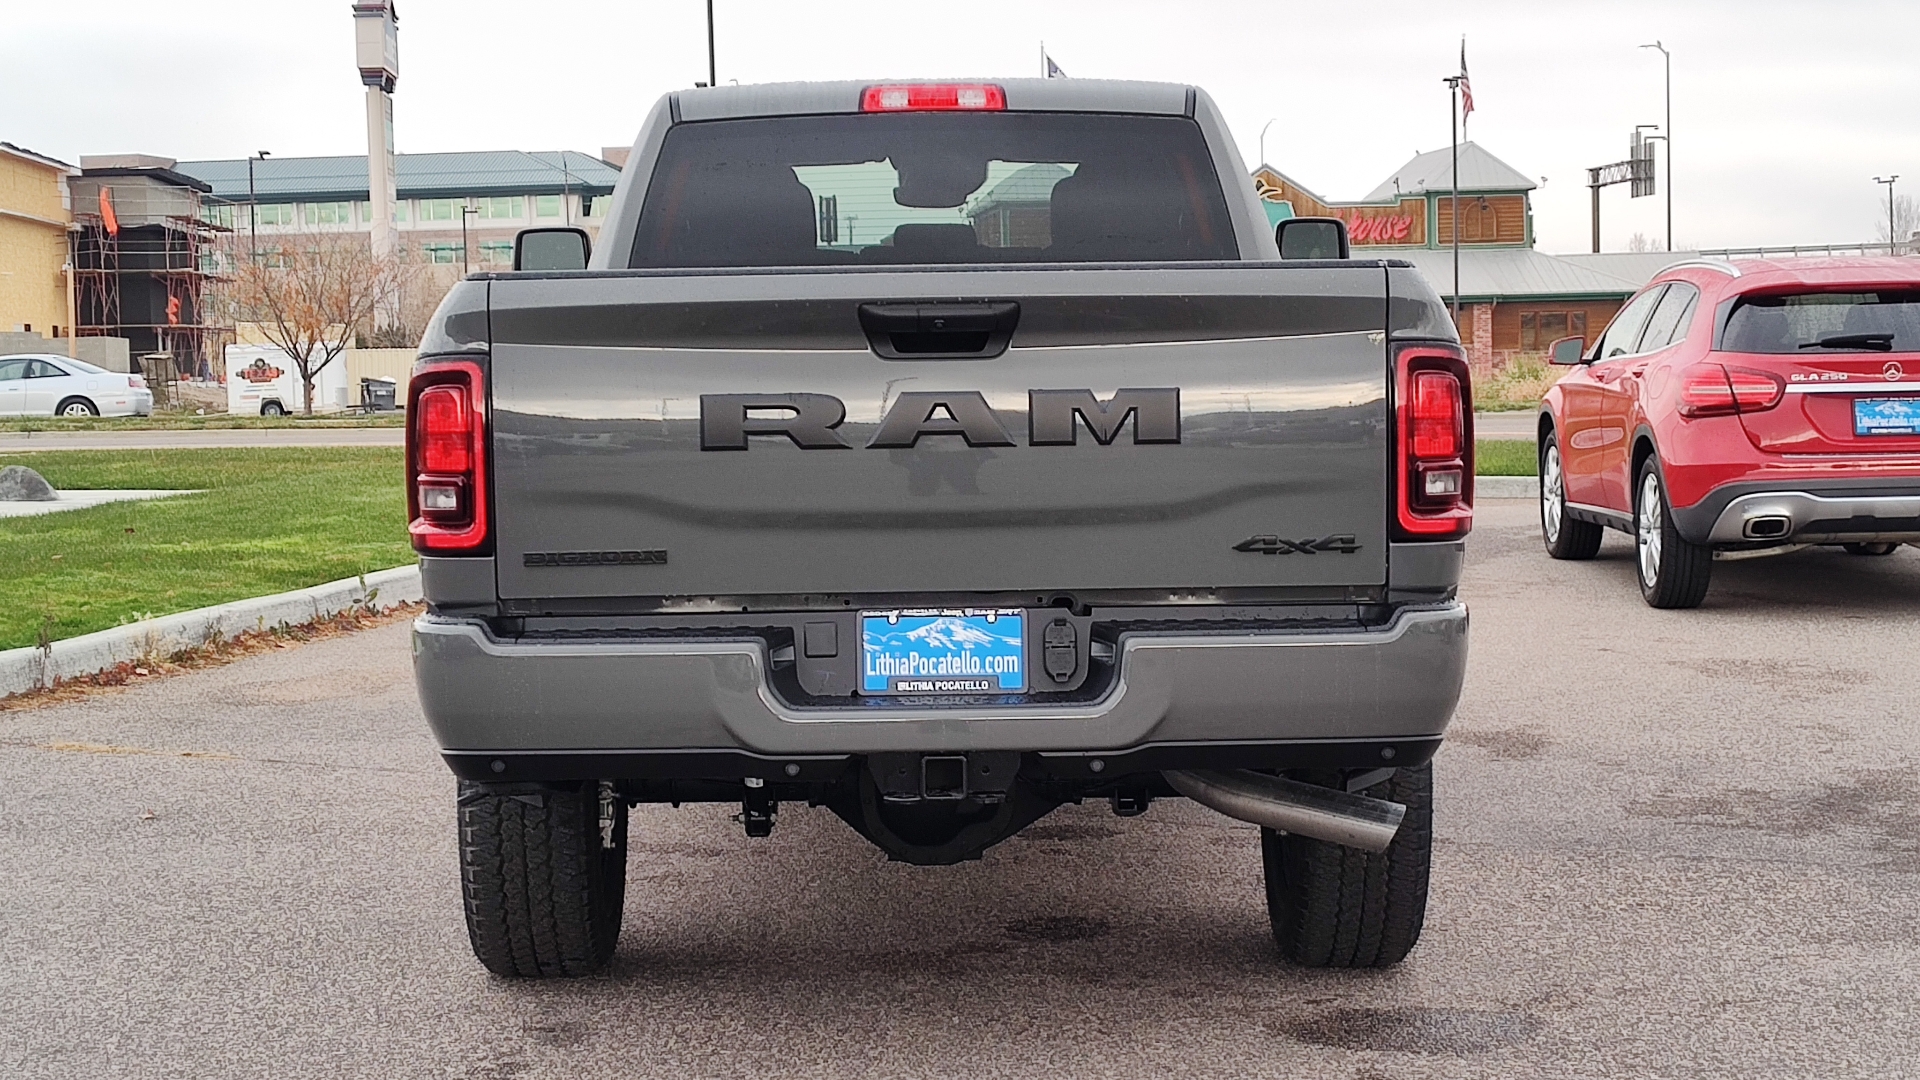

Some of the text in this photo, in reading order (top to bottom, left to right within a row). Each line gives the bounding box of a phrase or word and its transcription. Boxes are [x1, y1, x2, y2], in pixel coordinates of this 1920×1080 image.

[1337, 209, 1413, 241] house
[1790, 372, 1848, 382] GLA 250
[699, 387, 1181, 451] RAM
[867, 651, 1019, 676] LithiaPocatello.com
[935, 680, 989, 690] POCATELLO
